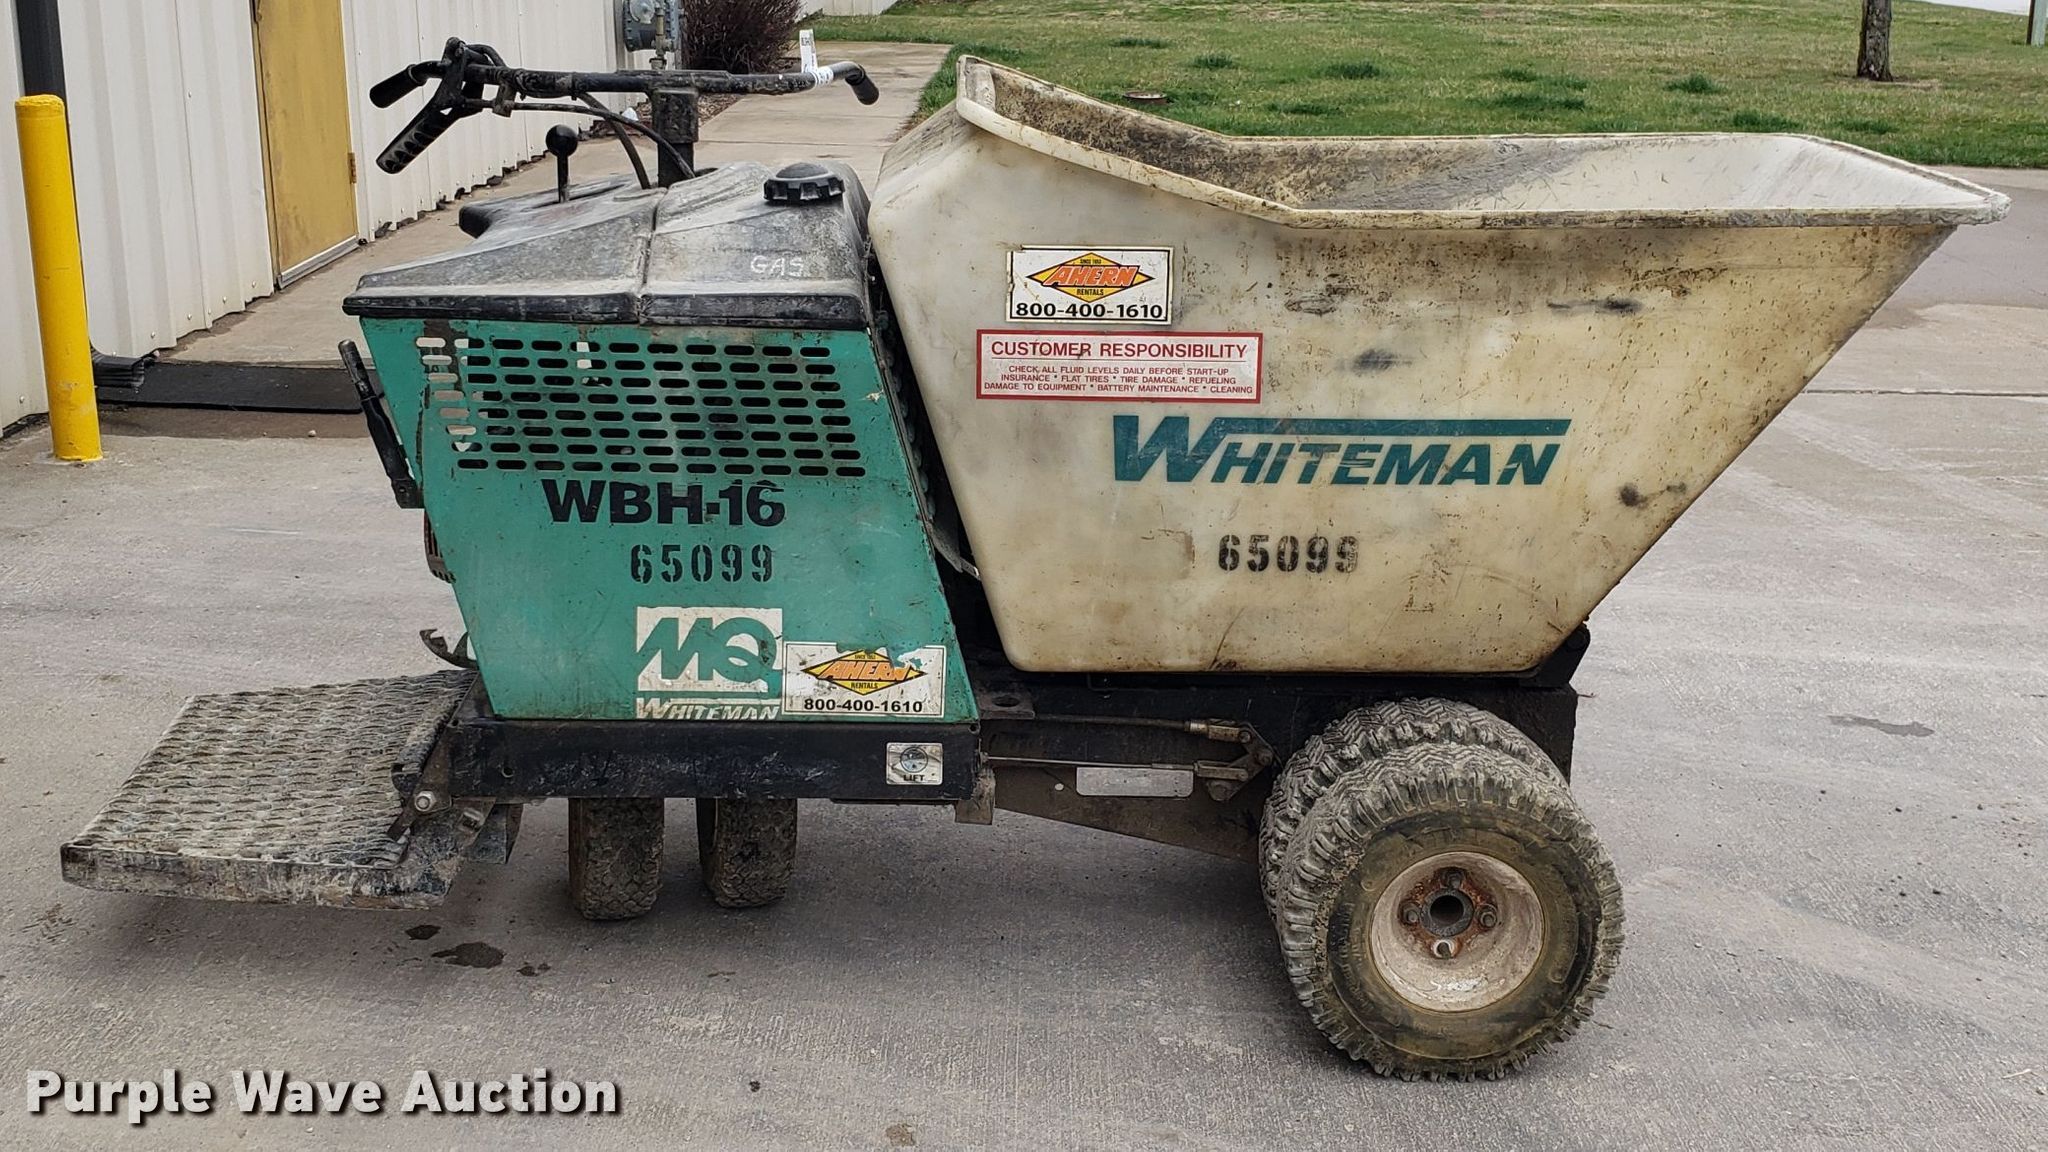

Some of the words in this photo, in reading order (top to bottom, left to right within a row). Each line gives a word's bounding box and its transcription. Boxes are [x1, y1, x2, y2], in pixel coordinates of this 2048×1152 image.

[750, 255, 804, 276] GAS
[1042, 266, 1139, 286] AHERN
[1076, 288, 1104, 296] RENTALS
[1015, 302, 1163, 319] 800-400-1610
[991, 341, 1092, 356] CUSTOMER
[1100, 343, 1247, 358] RESPONSIBILITY
[1008, 365, 1038, 373] CHECK
[1060, 366, 1084, 374] FLUID
[984, 382, 1019, 390] DAMAGE
[1037, 383, 1087, 391] EQUIPMENT
[1097, 384, 1135, 392] BATTERY
[1138, 384, 1199, 393] MAINTENANCE
[1210, 385, 1253, 393] CLEANING
[1084, 375, 1109, 383] TIRES
[1113, 415, 1572, 485] WHITEMAN
[541, 479, 786, 527] WBH-16
[1217, 534, 1359, 573] 65099
[630, 544, 773, 584] 65099
[637, 611, 781, 688] MQ
[850, 682, 878, 690] RENTALS
[636, 697, 780, 720] WHITEMAN
[803, 699, 923, 713] 800-400-1610
